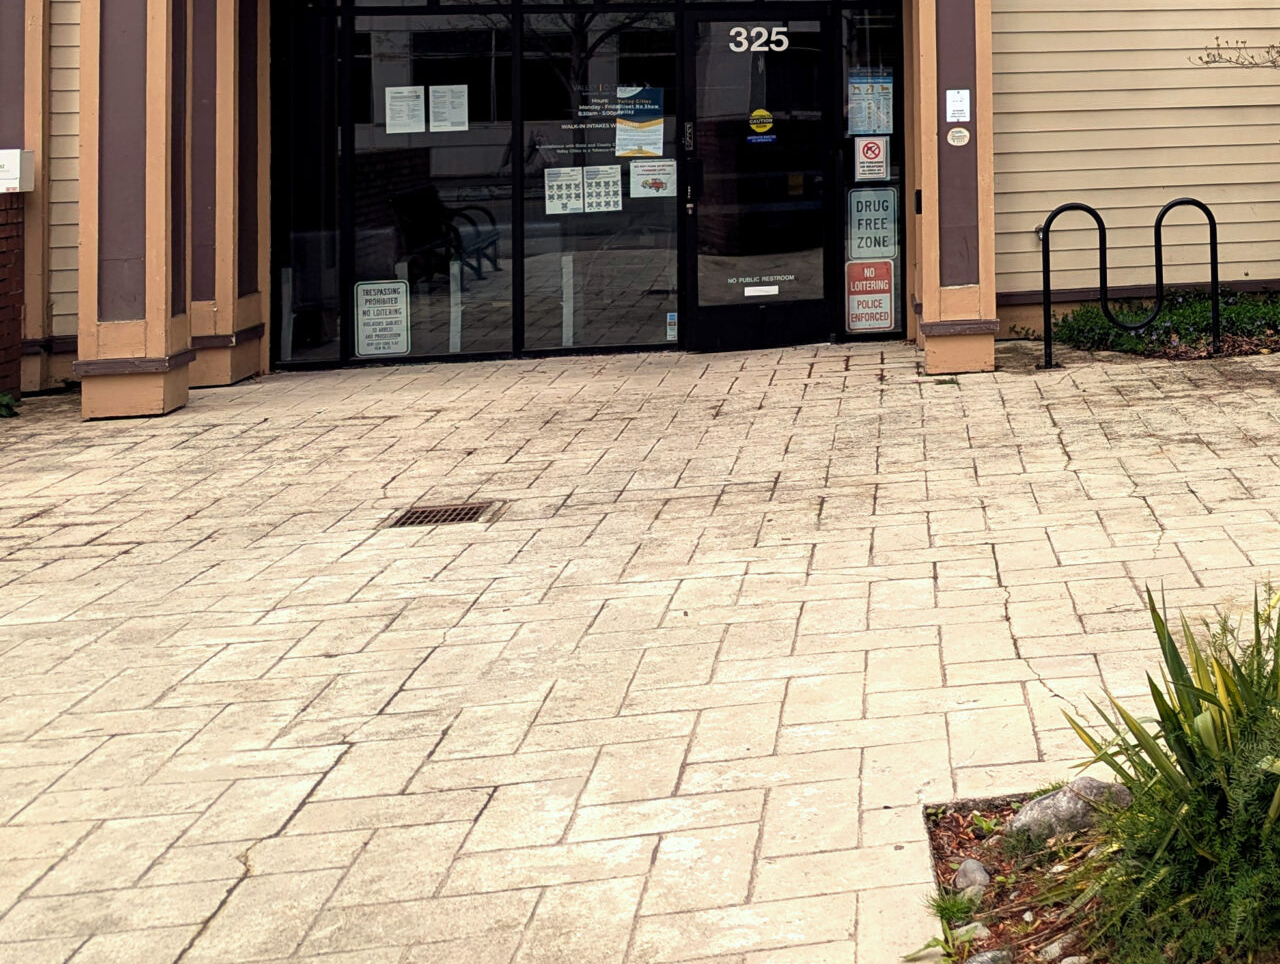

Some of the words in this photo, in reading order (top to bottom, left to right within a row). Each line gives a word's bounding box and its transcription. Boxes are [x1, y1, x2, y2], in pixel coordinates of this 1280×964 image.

[728, 26, 789, 52] 325
[856, 200, 889, 213] DRUG
[858, 218, 888, 230] FREE
[857, 236, 889, 249] ZONE
[864, 268, 875, 277] NO
[850, 280, 889, 291] LOITERING
[362, 288, 401, 296] TRESPASSING
[856, 299, 883, 309] POLICE
[373, 308, 402, 316] LOITERING
[851, 312, 889, 322] ENFORCED
